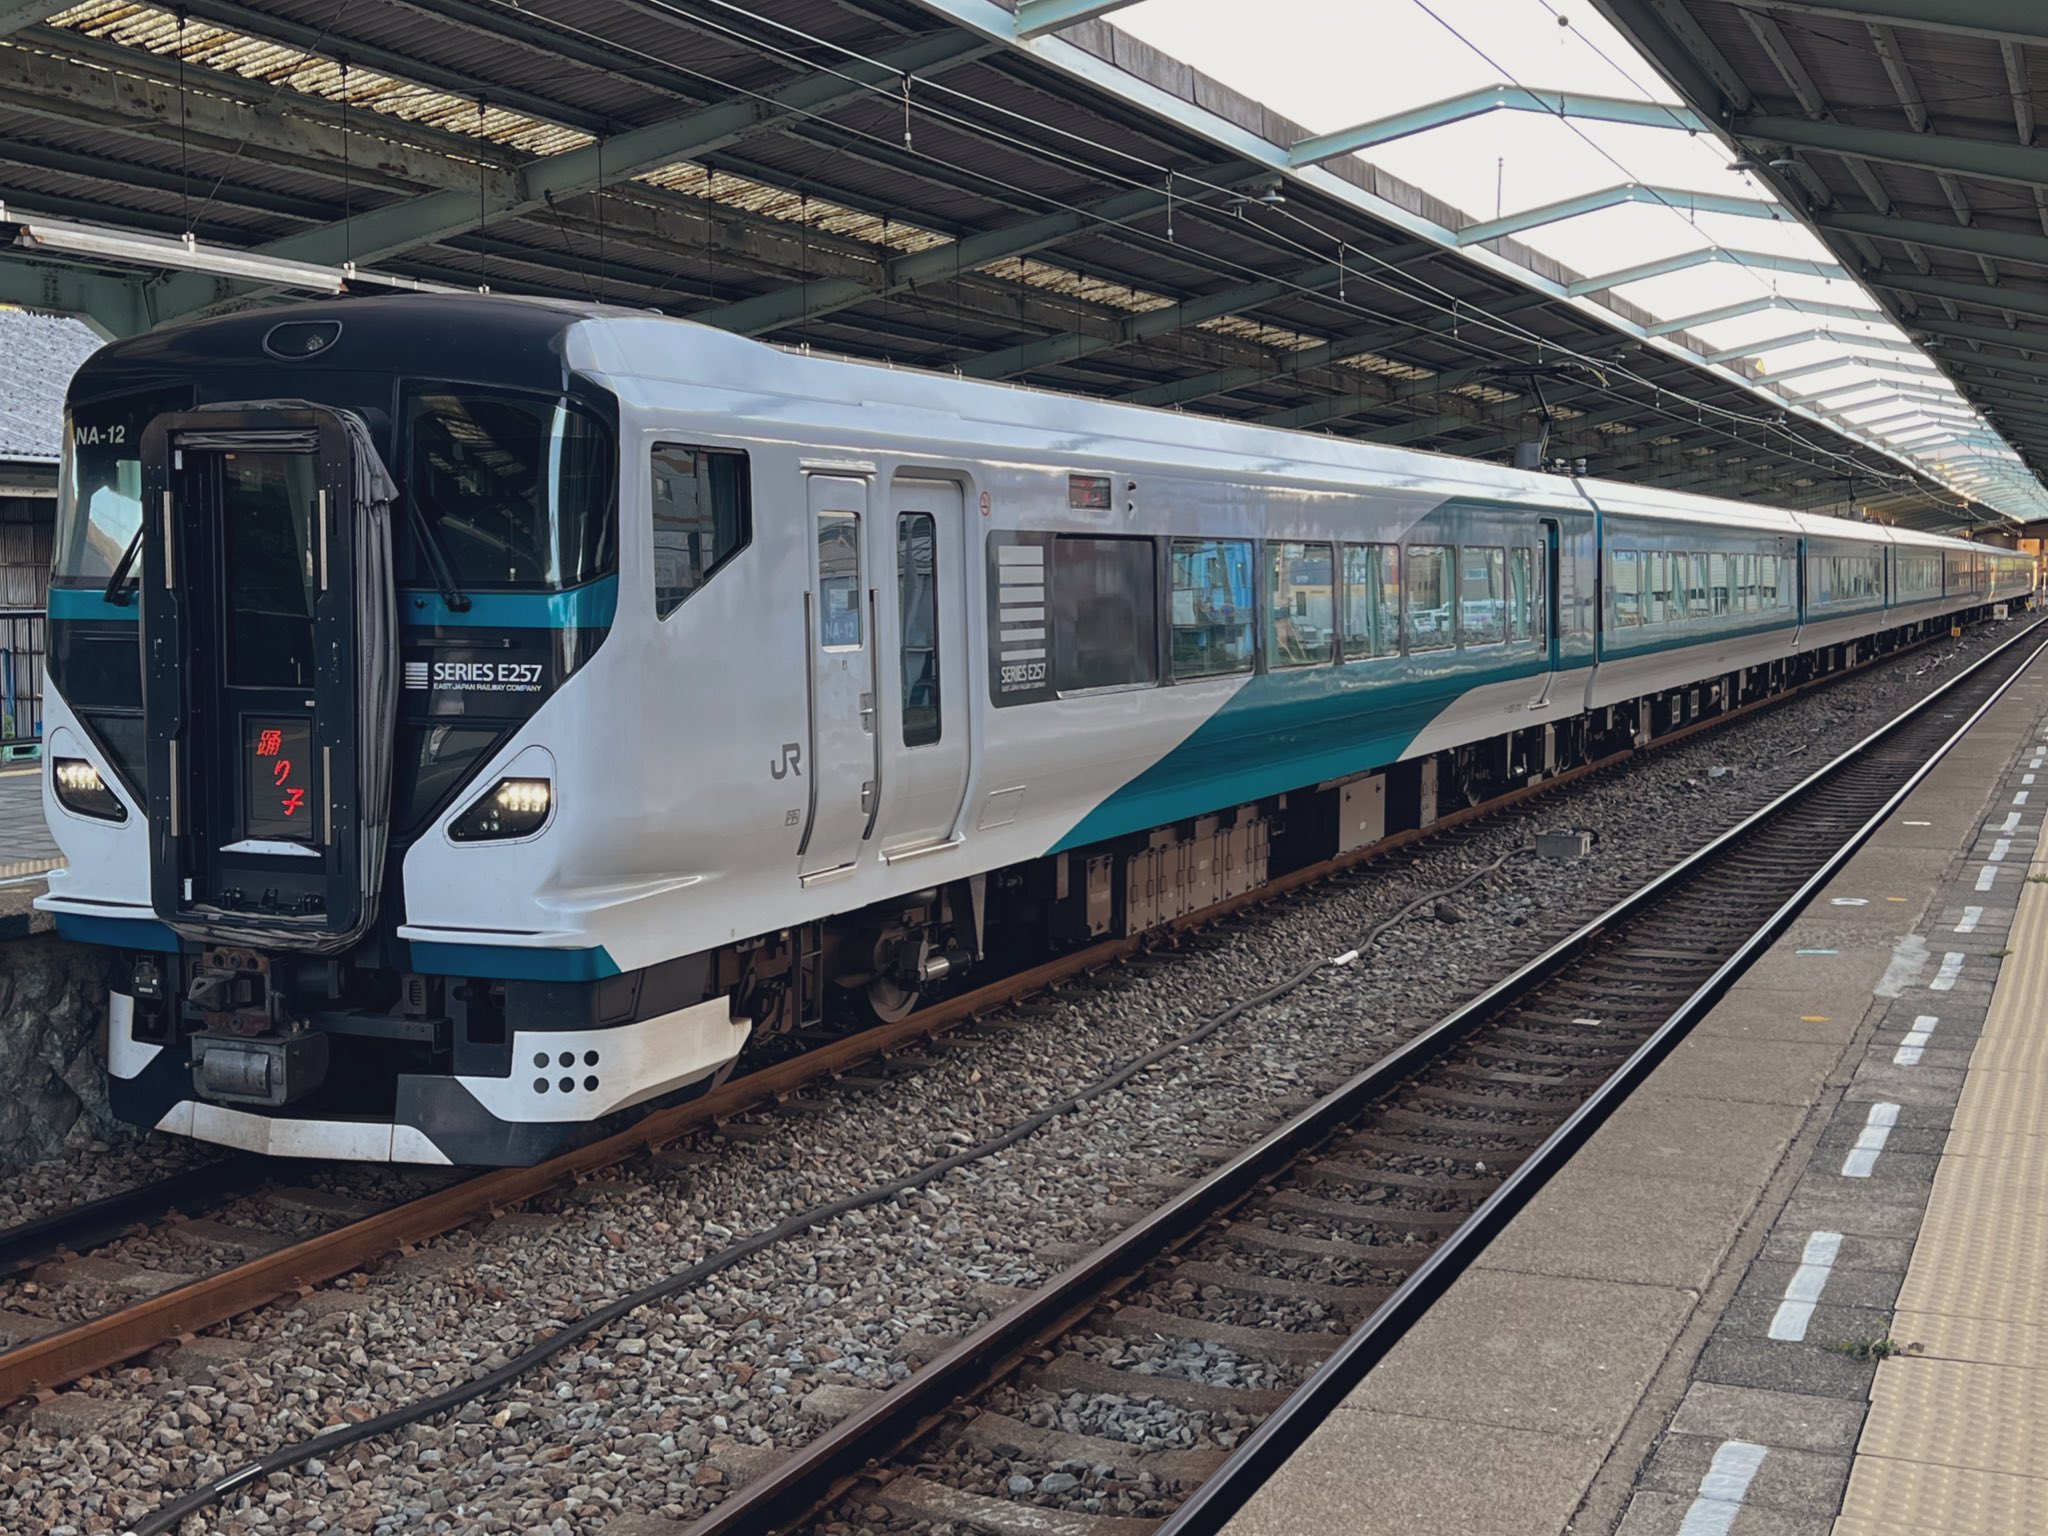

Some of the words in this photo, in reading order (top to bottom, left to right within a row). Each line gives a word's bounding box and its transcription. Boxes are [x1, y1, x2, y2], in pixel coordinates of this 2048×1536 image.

[76, 425, 126, 445] NA-12
[825, 621, 856, 640] NA-12
[433, 662, 494, 681] SERIES
[498, 664, 542, 682] E257
[1001, 664, 1027, 684] SERIES
[1028, 662, 1046, 680] E257
[433, 682, 452, 690] EAST
[452, 683, 476, 691] JAPAN
[476, 683, 506, 692] RAILWAY
[506, 684, 542, 692] COMPANY
[770, 742, 802, 780] JR
[256, 729, 305, 816] 踊り子
